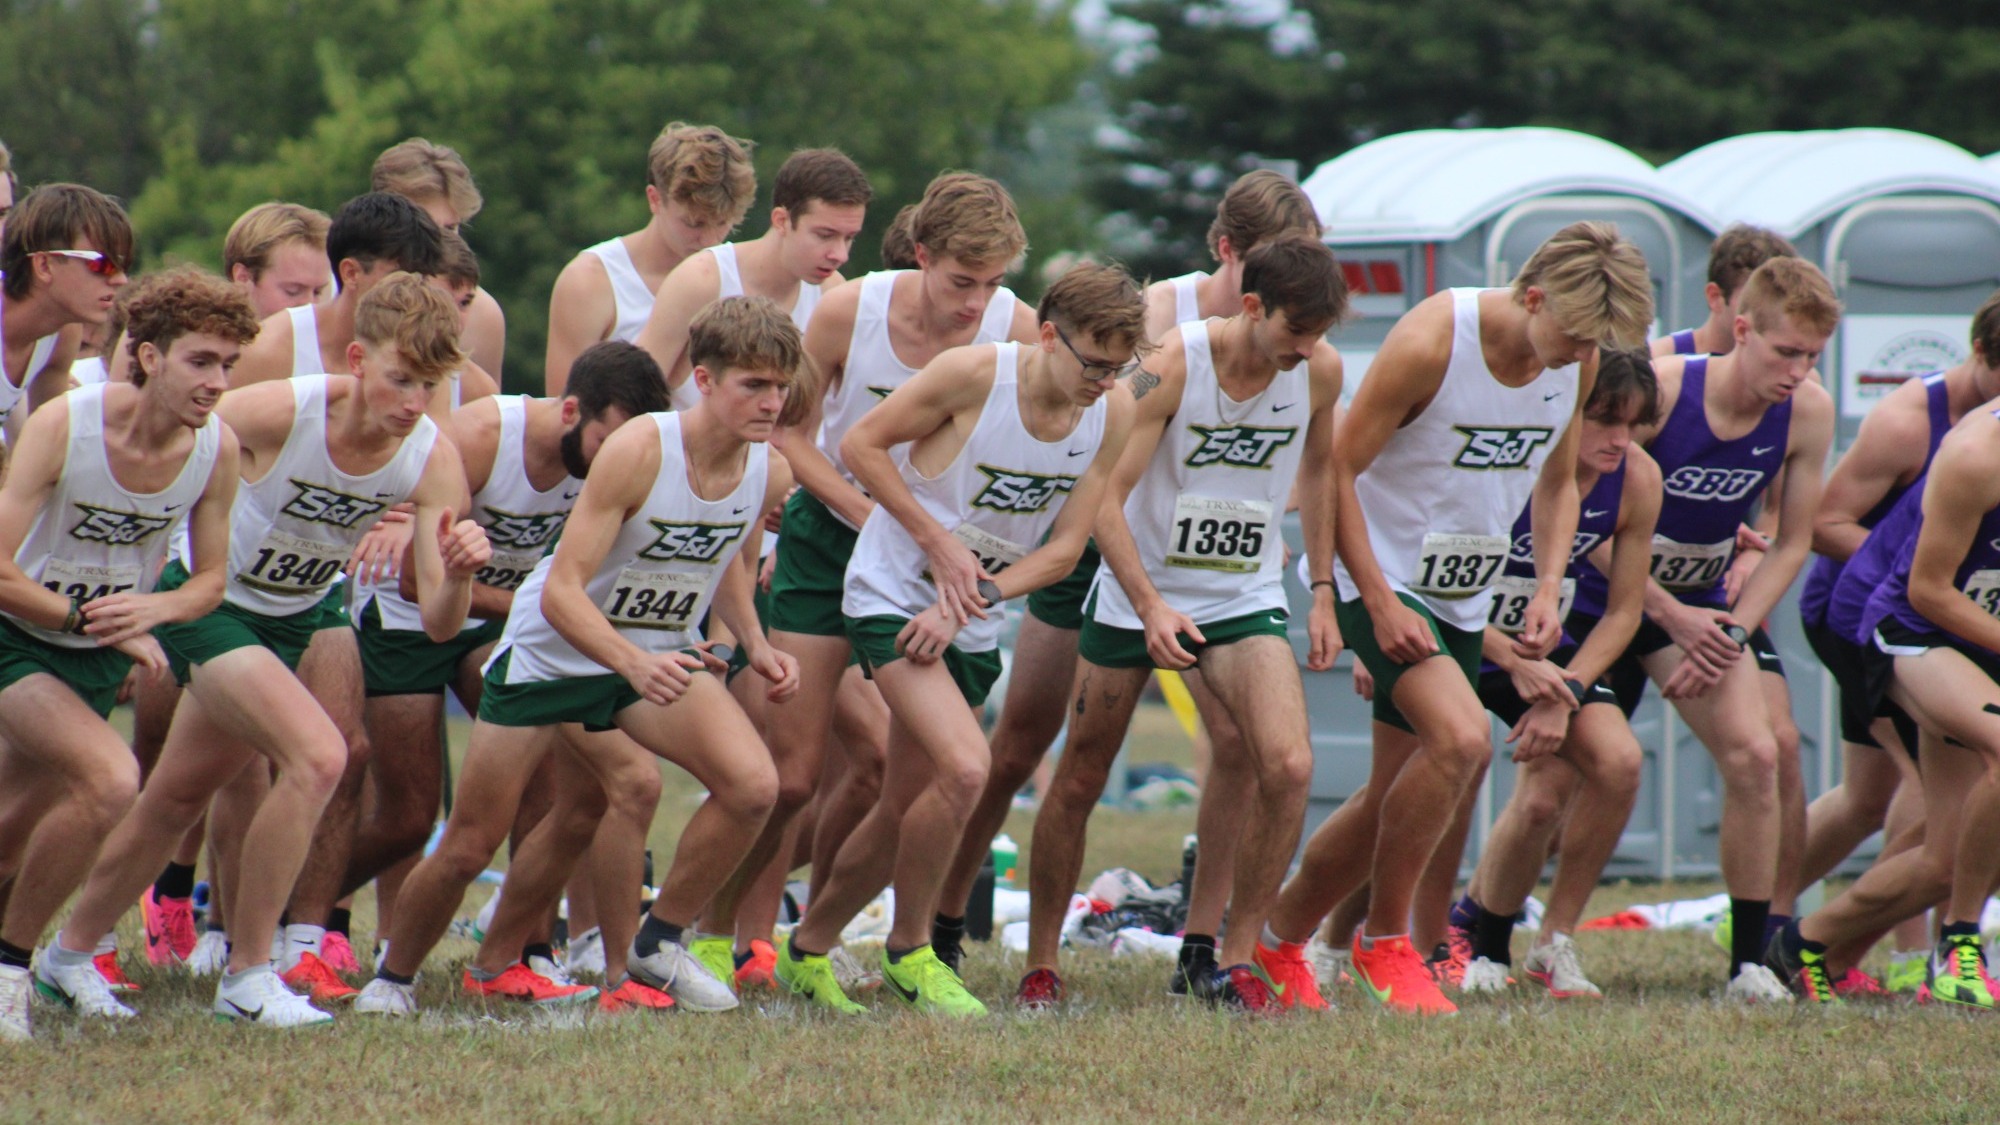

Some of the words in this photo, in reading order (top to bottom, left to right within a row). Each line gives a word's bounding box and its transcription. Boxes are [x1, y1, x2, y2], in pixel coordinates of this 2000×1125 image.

[1185, 425, 1298, 468] S&T
[1453, 425, 1554, 469] S&T
[280, 478, 387, 529] S&T
[972, 464, 1077, 513] S&T
[1664, 466, 1764, 501] SBU
[71, 502, 173, 545] S&T
[638, 519, 747, 563] S&T
[1176, 517, 1266, 558] 1335
[250, 548, 342, 586] 1340
[1420, 554, 1504, 589] 1337
[1650, 554, 1725, 582] 1370
[609, 586, 699, 621] 1344
